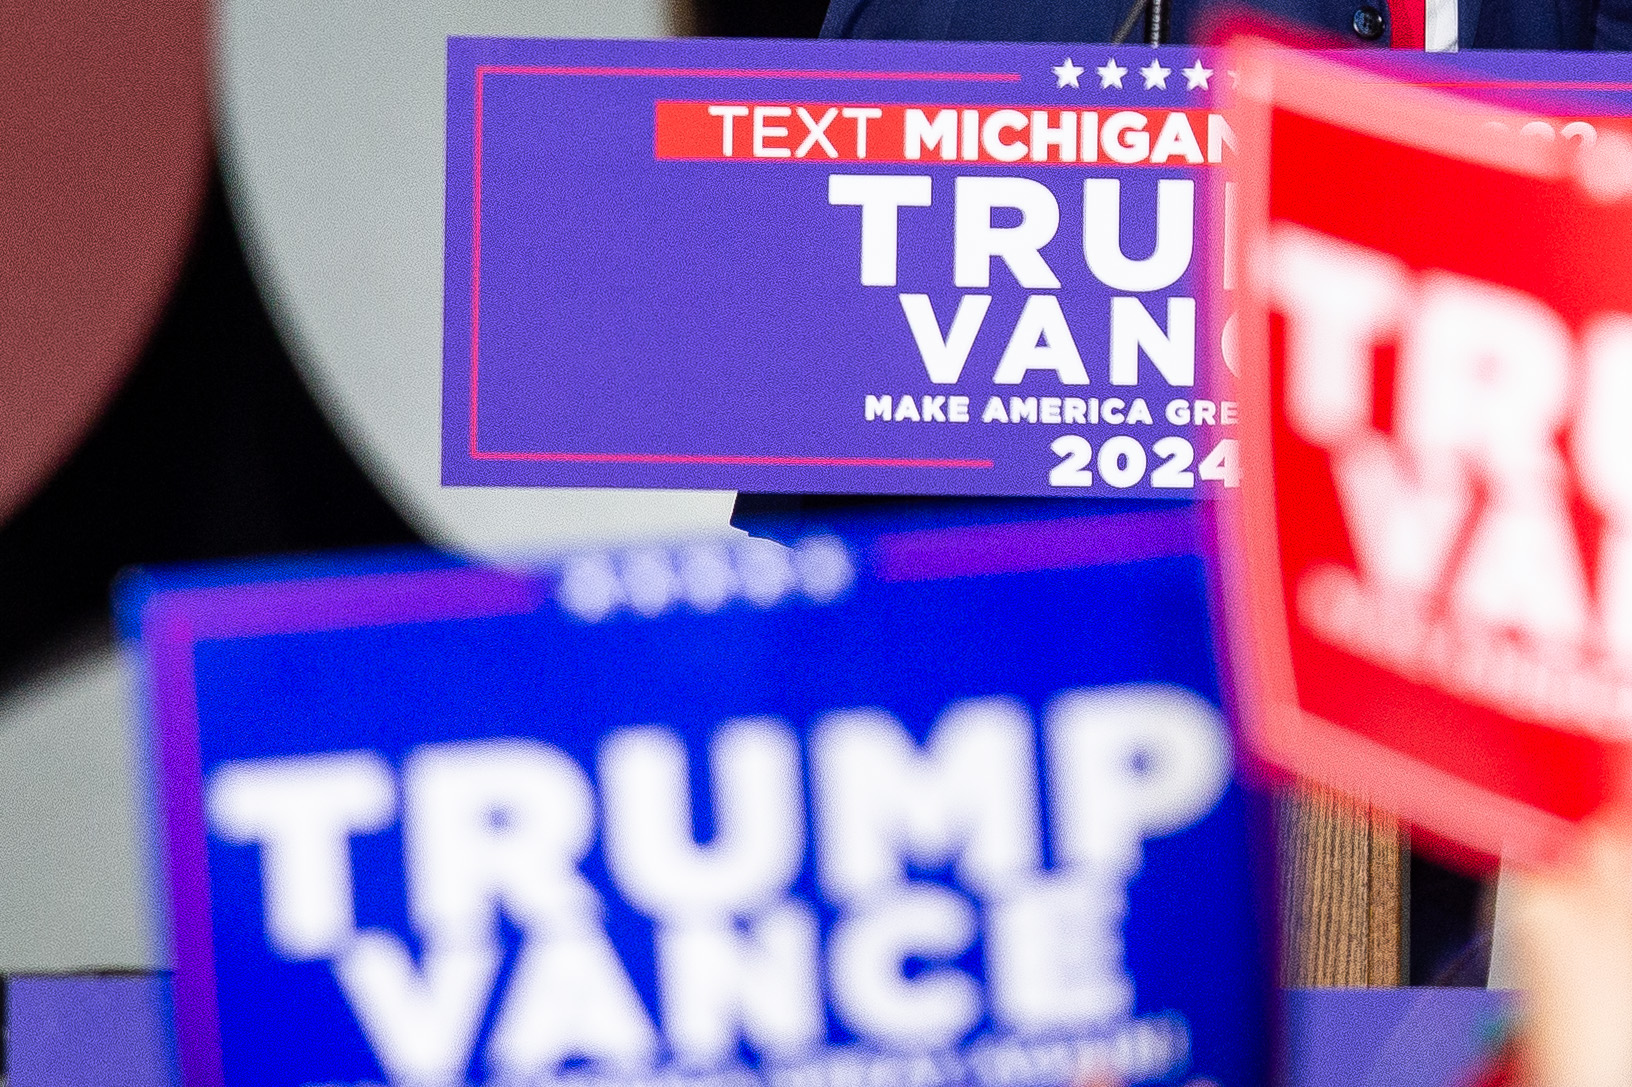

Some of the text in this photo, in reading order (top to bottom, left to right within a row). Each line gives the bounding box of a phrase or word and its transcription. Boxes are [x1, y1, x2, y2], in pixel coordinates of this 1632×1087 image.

[708, 105, 883, 159] TEXT
[827, 173, 1238, 292] TRU
[898, 292, 1238, 387] VAN
[864, 394, 1239, 426] MAKE AMERICA GRE
[1048, 433, 1242, 490] 2024
[203, 682, 1236, 962] TRUMP
[330, 867, 1138, 1087] VANCE
